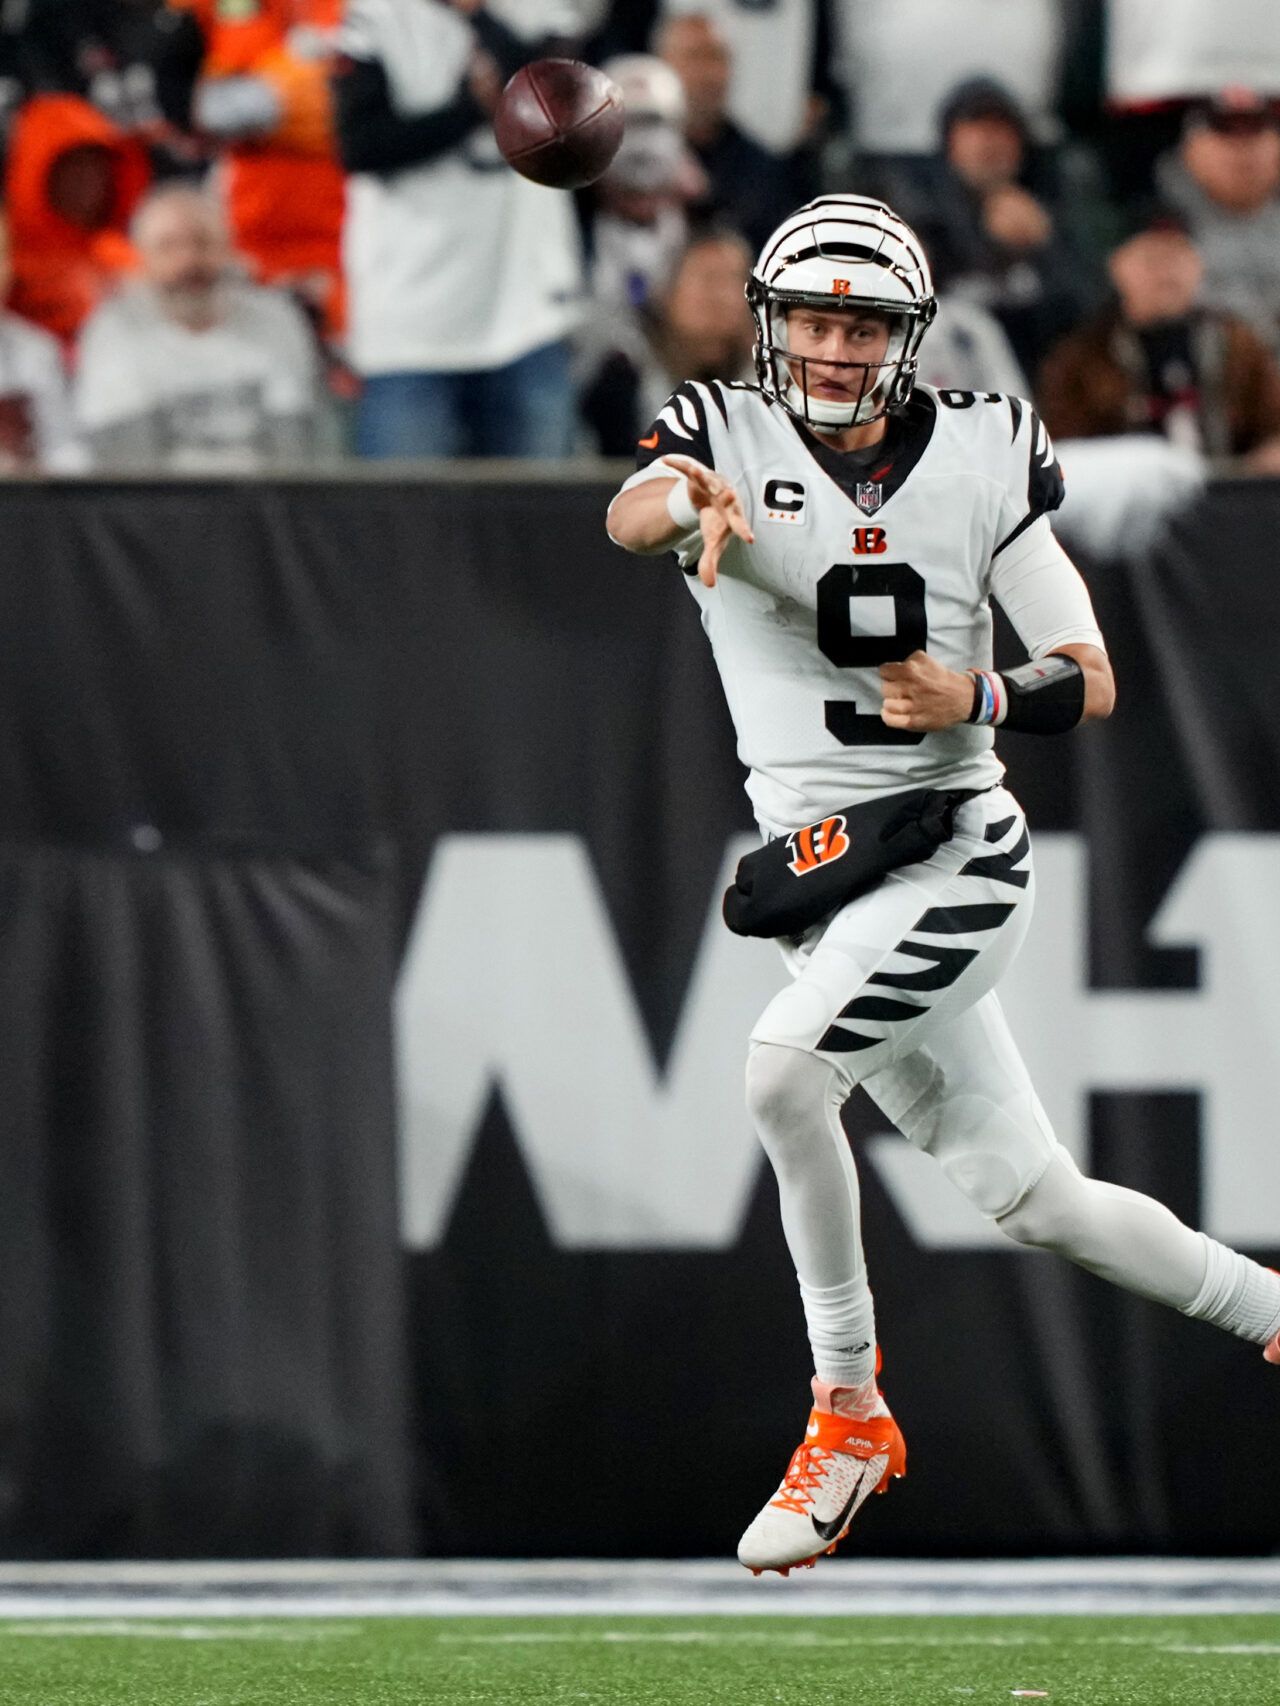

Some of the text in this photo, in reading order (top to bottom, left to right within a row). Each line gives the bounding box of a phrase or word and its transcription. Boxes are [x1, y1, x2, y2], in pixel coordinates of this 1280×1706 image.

[763, 479, 805, 512] C
[851, 527, 888, 555] B
[816, 562, 928, 747] 9
[785, 814, 850, 878] B
